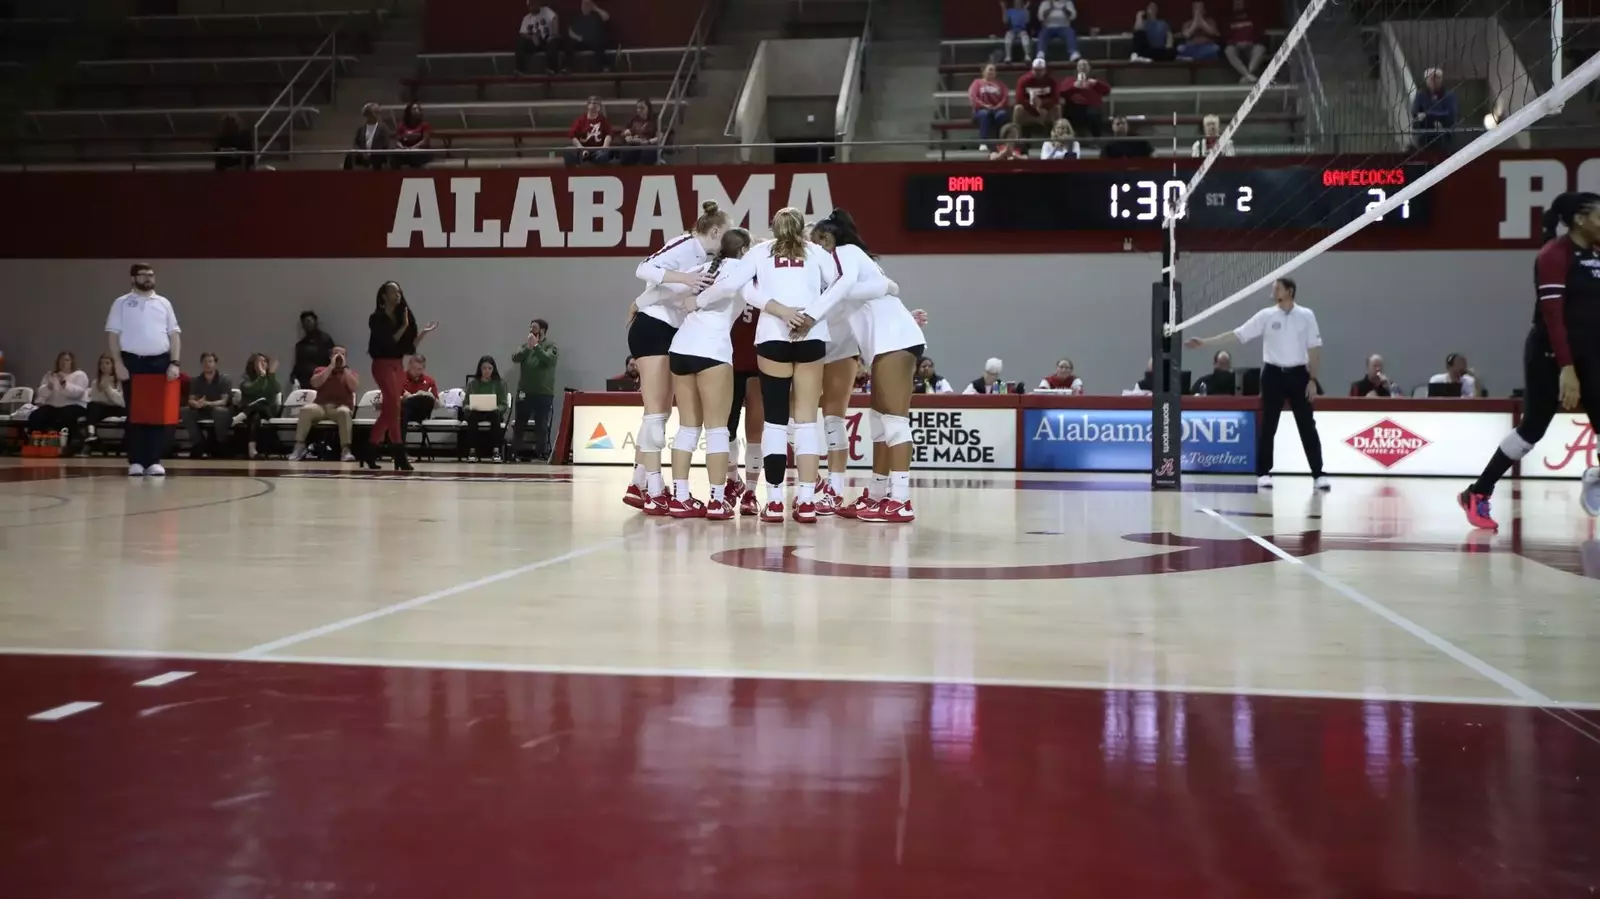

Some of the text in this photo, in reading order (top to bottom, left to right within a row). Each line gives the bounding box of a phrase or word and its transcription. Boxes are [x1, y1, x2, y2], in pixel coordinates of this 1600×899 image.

[949, 176, 984, 192] BAMA
[1323, 169, 1406, 186] GAMECOCKS
[1110, 181, 1187, 220] 1:30
[1206, 186, 1253, 212] SET 2
[386, 173, 838, 249] ALABAMA
[934, 195, 975, 227] 20
[909, 412, 962, 428] HERE
[911, 429, 981, 446] GENDS
[1373, 426, 1403, 439] RED
[1353, 436, 1423, 449] DIAMOND
[933, 447, 995, 463] MADE
